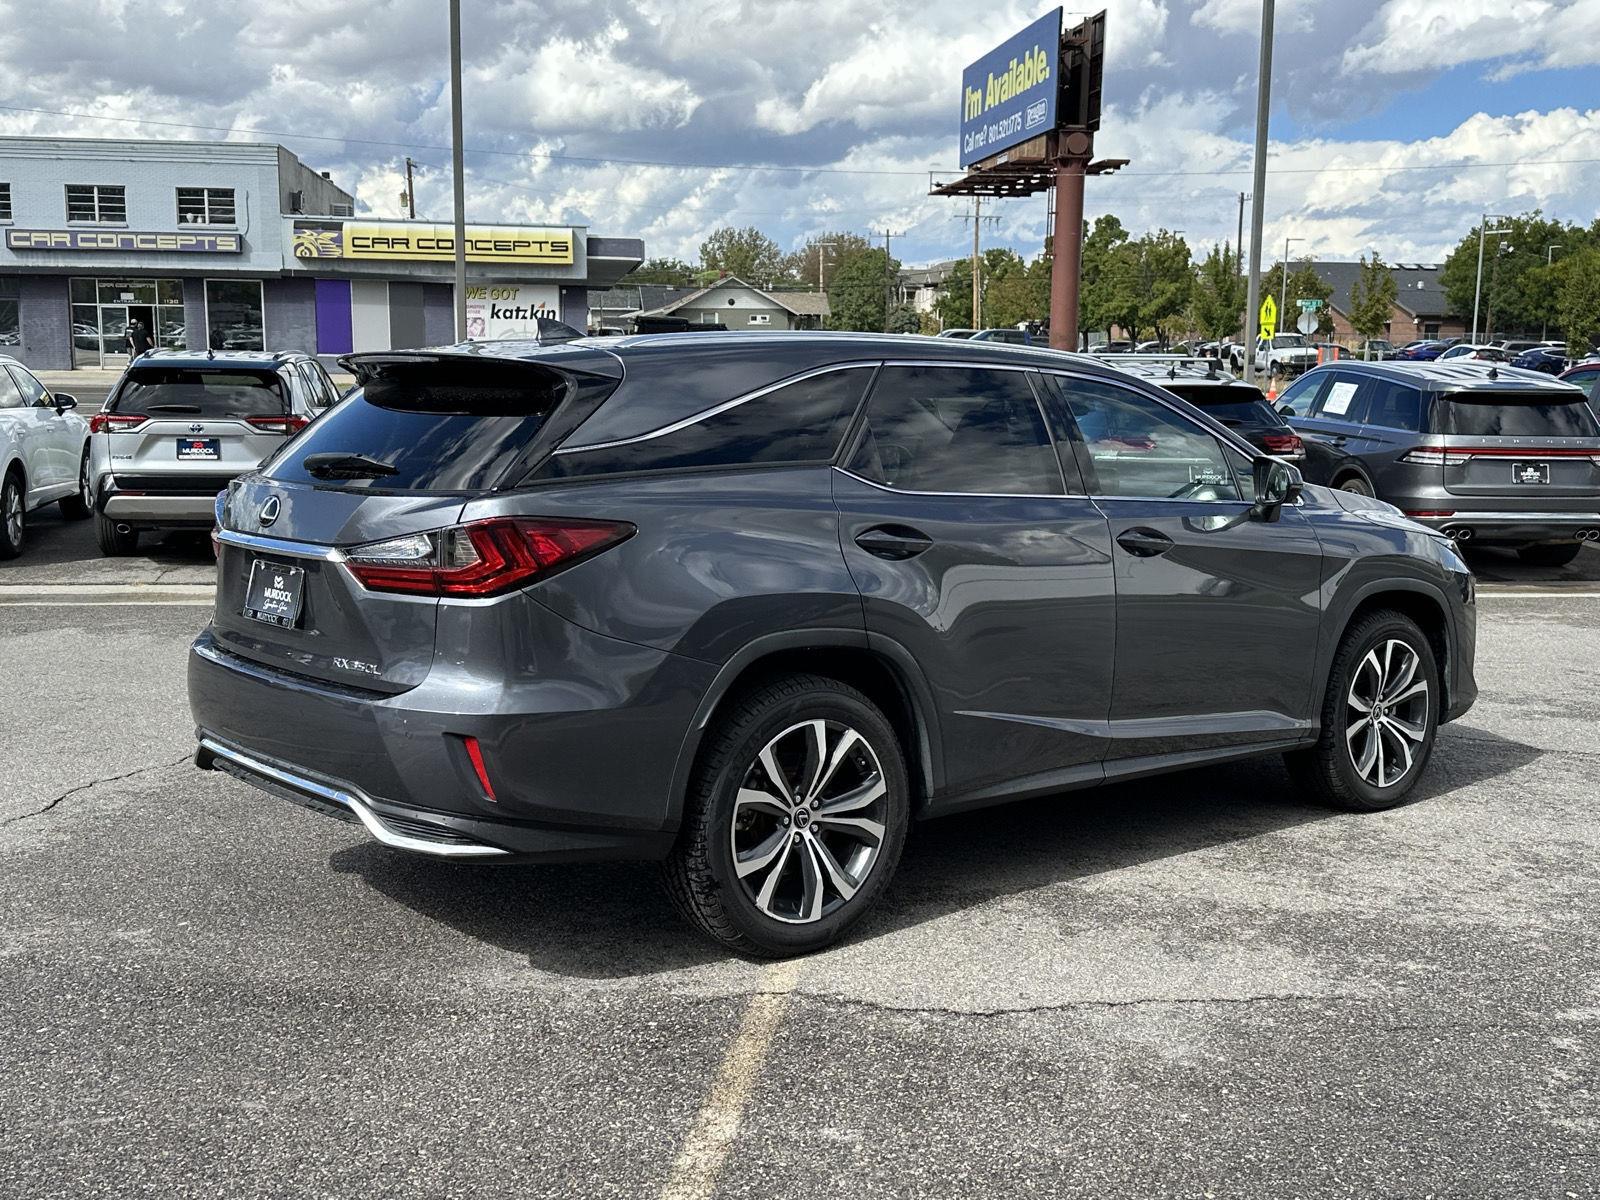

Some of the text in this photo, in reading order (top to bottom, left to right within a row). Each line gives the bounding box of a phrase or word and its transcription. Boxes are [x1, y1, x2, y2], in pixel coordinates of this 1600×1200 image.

[964, 45, 1049, 123] I'm Available.
[964, 130, 974, 154] Call
[975, 125, 987, 146] me?
[10, 231, 236, 251] CAR CONCEPTS
[351, 236, 410, 250] CAR
[465, 286, 520, 301] WE GOT
[490, 303, 556, 320] katzkin
[264, 587, 292, 602] MURDOCK
[333, 657, 349, 669] RX
